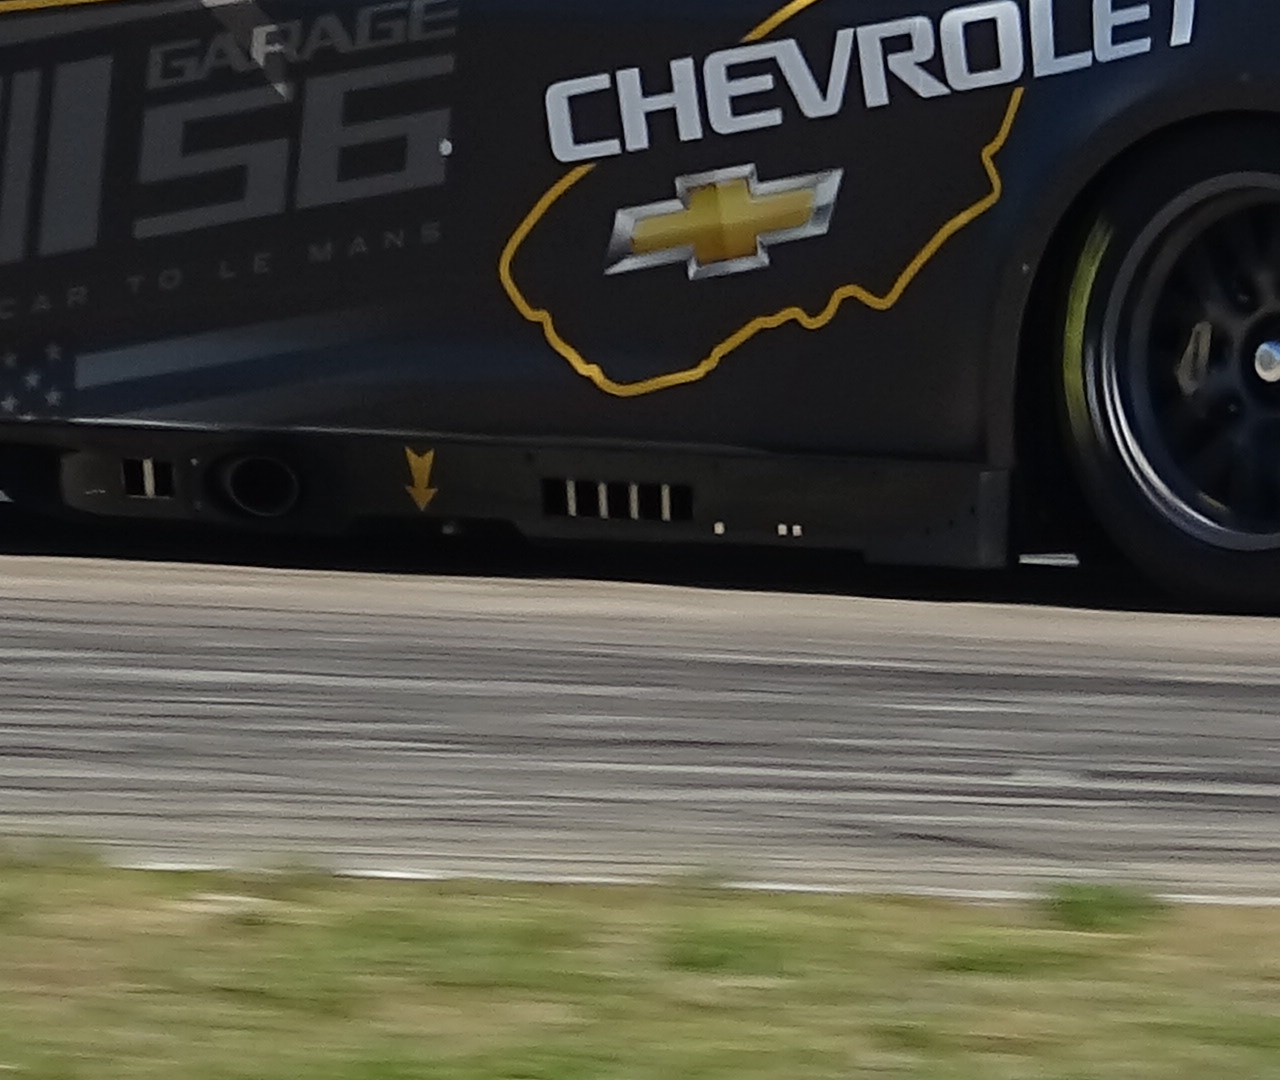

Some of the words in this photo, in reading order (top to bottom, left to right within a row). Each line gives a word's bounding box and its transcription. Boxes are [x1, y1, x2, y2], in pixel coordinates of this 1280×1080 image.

[132, 53, 457, 240] 56
[125, 266, 184, 297] TO
[218, 251, 275, 281] LE
[306, 220, 445, 264] MANS
